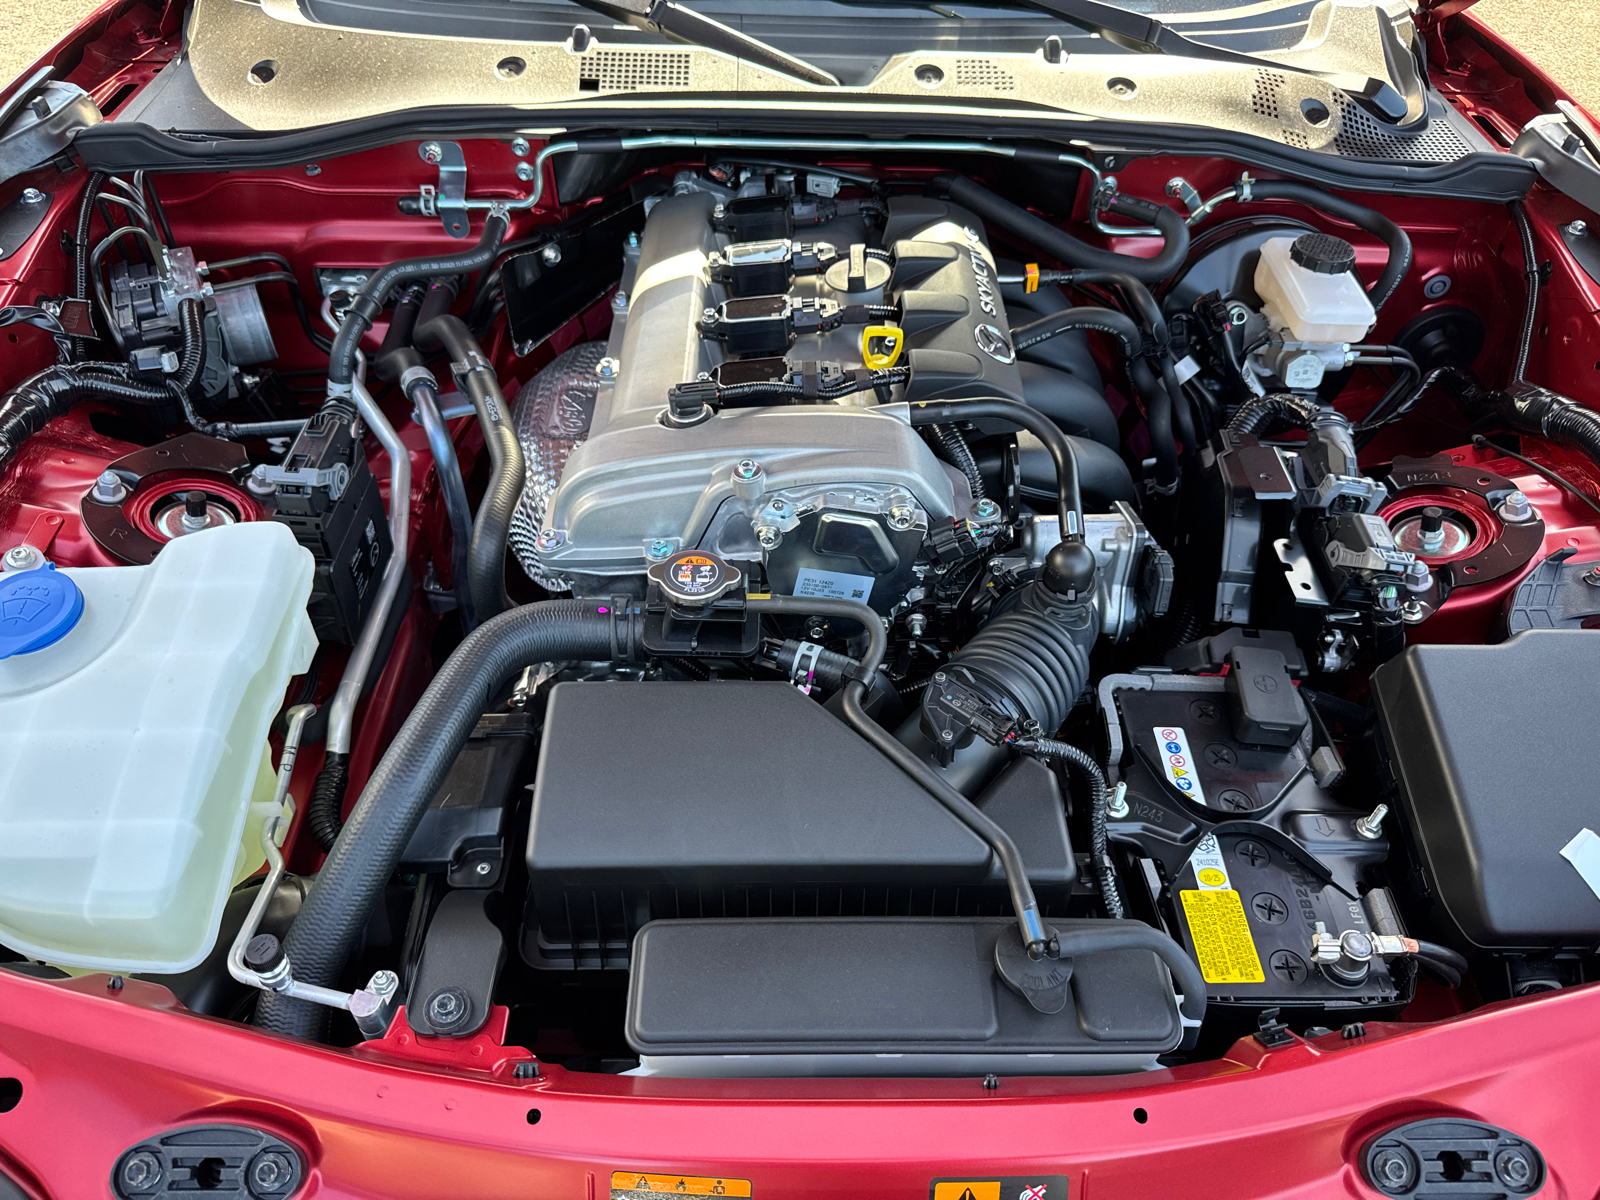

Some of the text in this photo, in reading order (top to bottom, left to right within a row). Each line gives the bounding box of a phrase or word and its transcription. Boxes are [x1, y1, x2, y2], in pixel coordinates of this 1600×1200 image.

[110, 528, 128, 540] R
[1132, 802, 1164, 822] N243
[1204, 903, 1218, 925] POISON
[1233, 905, 1248, 932] DANGER
